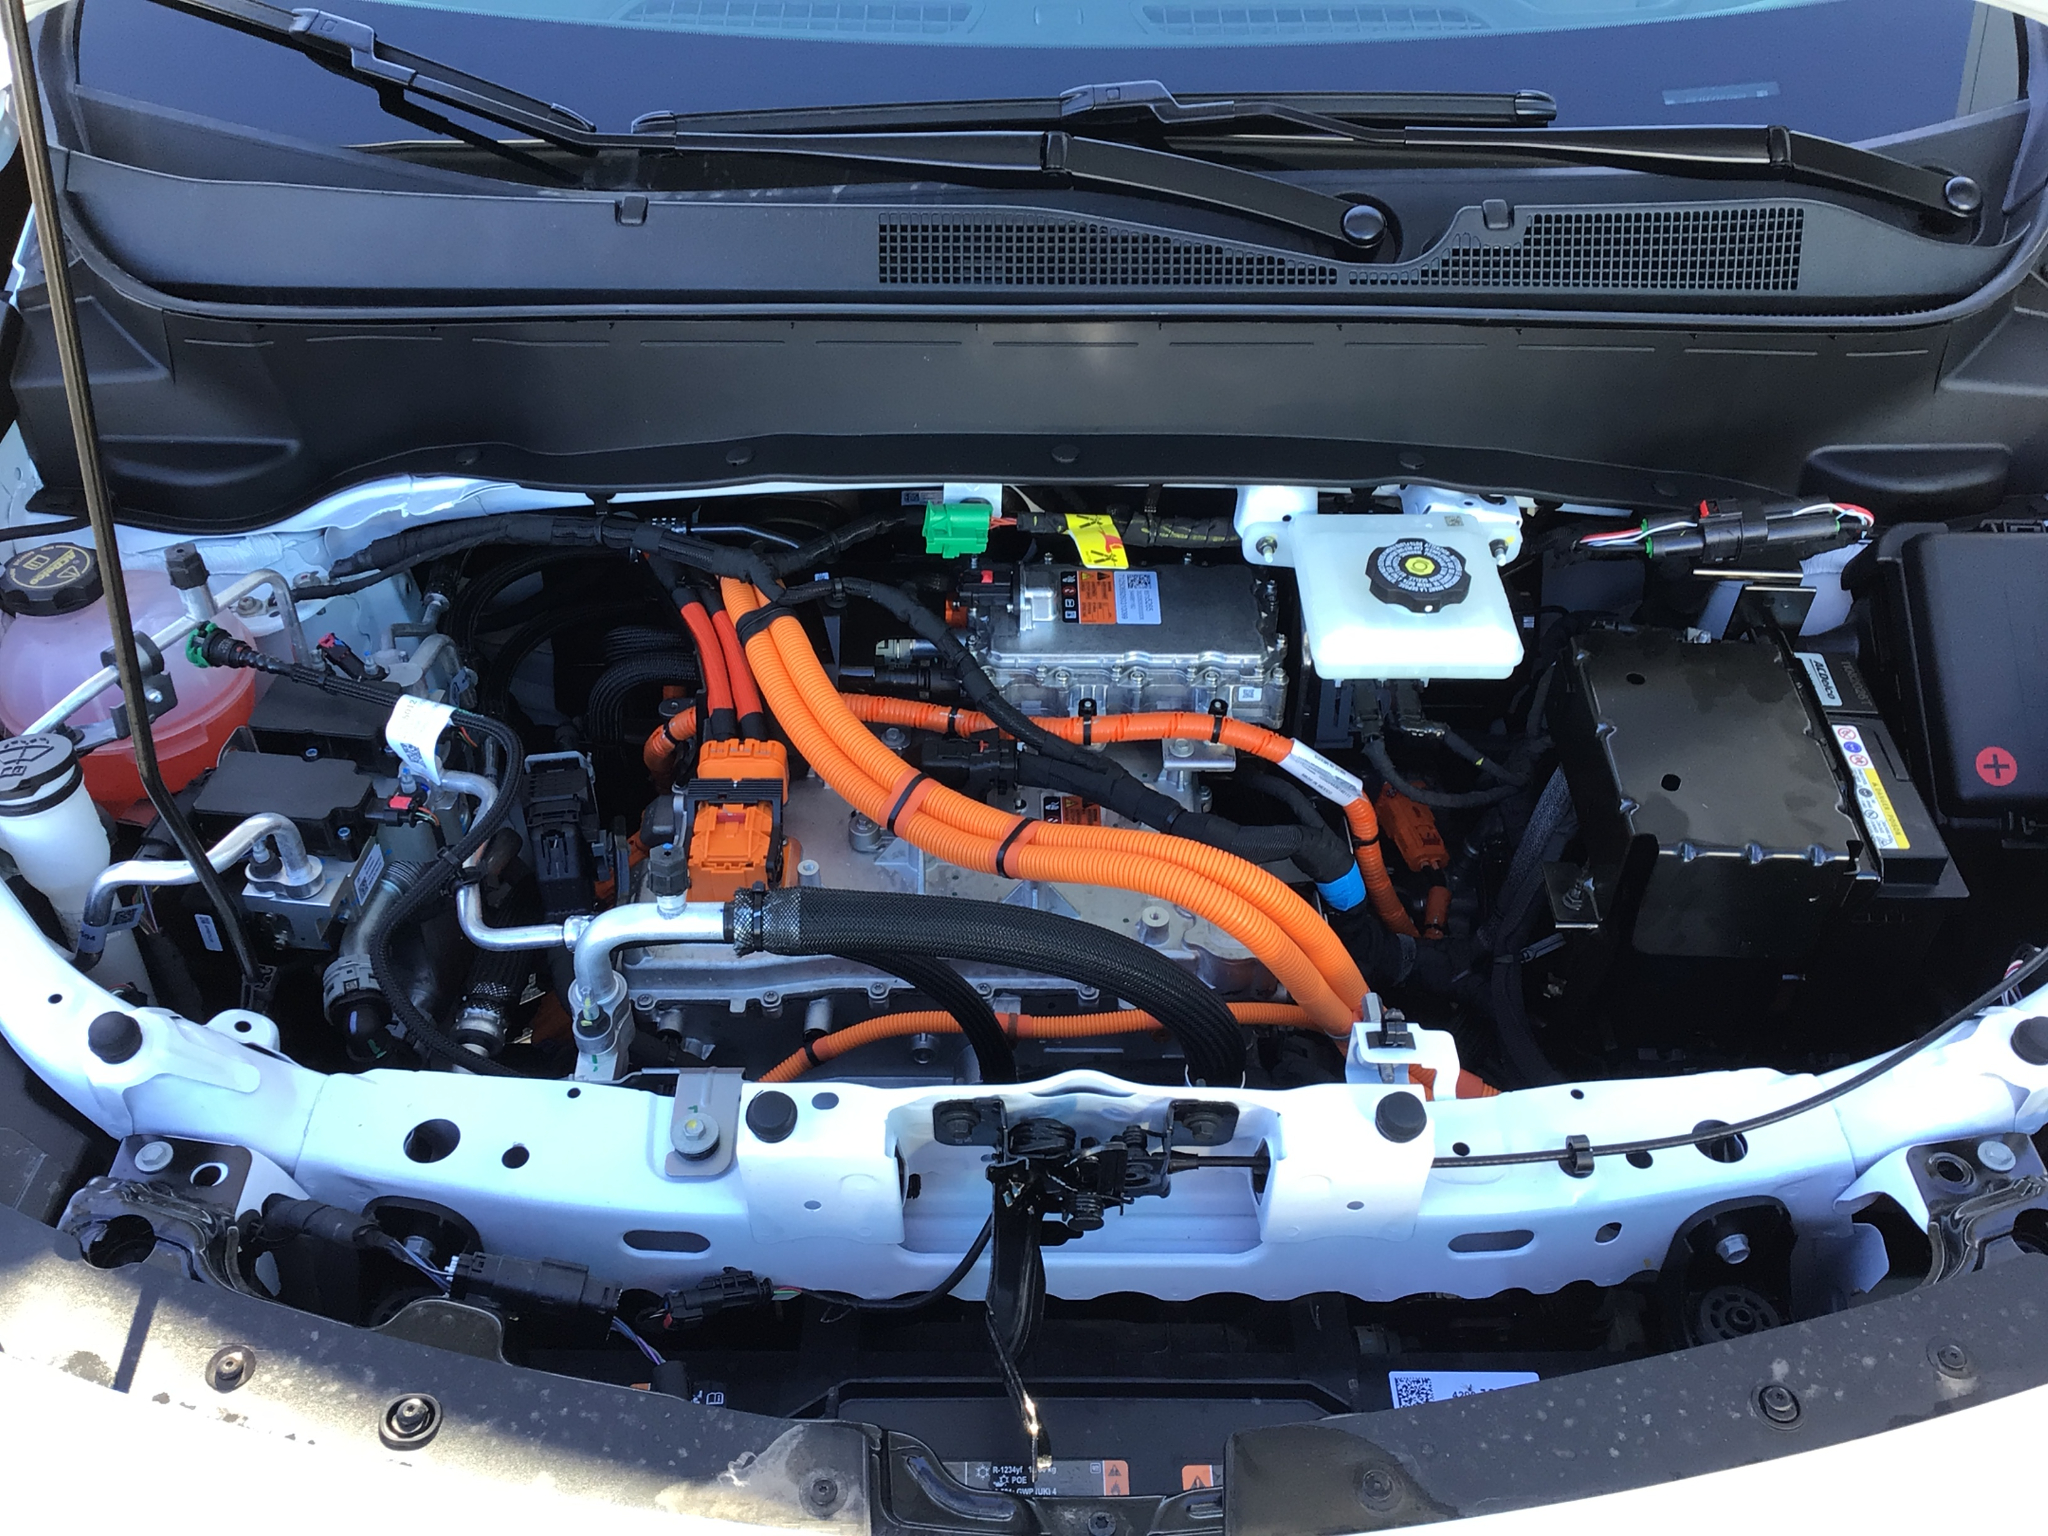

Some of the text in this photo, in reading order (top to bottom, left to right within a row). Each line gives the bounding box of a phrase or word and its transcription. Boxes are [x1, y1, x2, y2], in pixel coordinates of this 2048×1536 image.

[1813, 660, 1836, 700] ACDelco
[992, 1466, 1023, 1475] R-1234yf
[1011, 1476, 1027, 1484] POE
